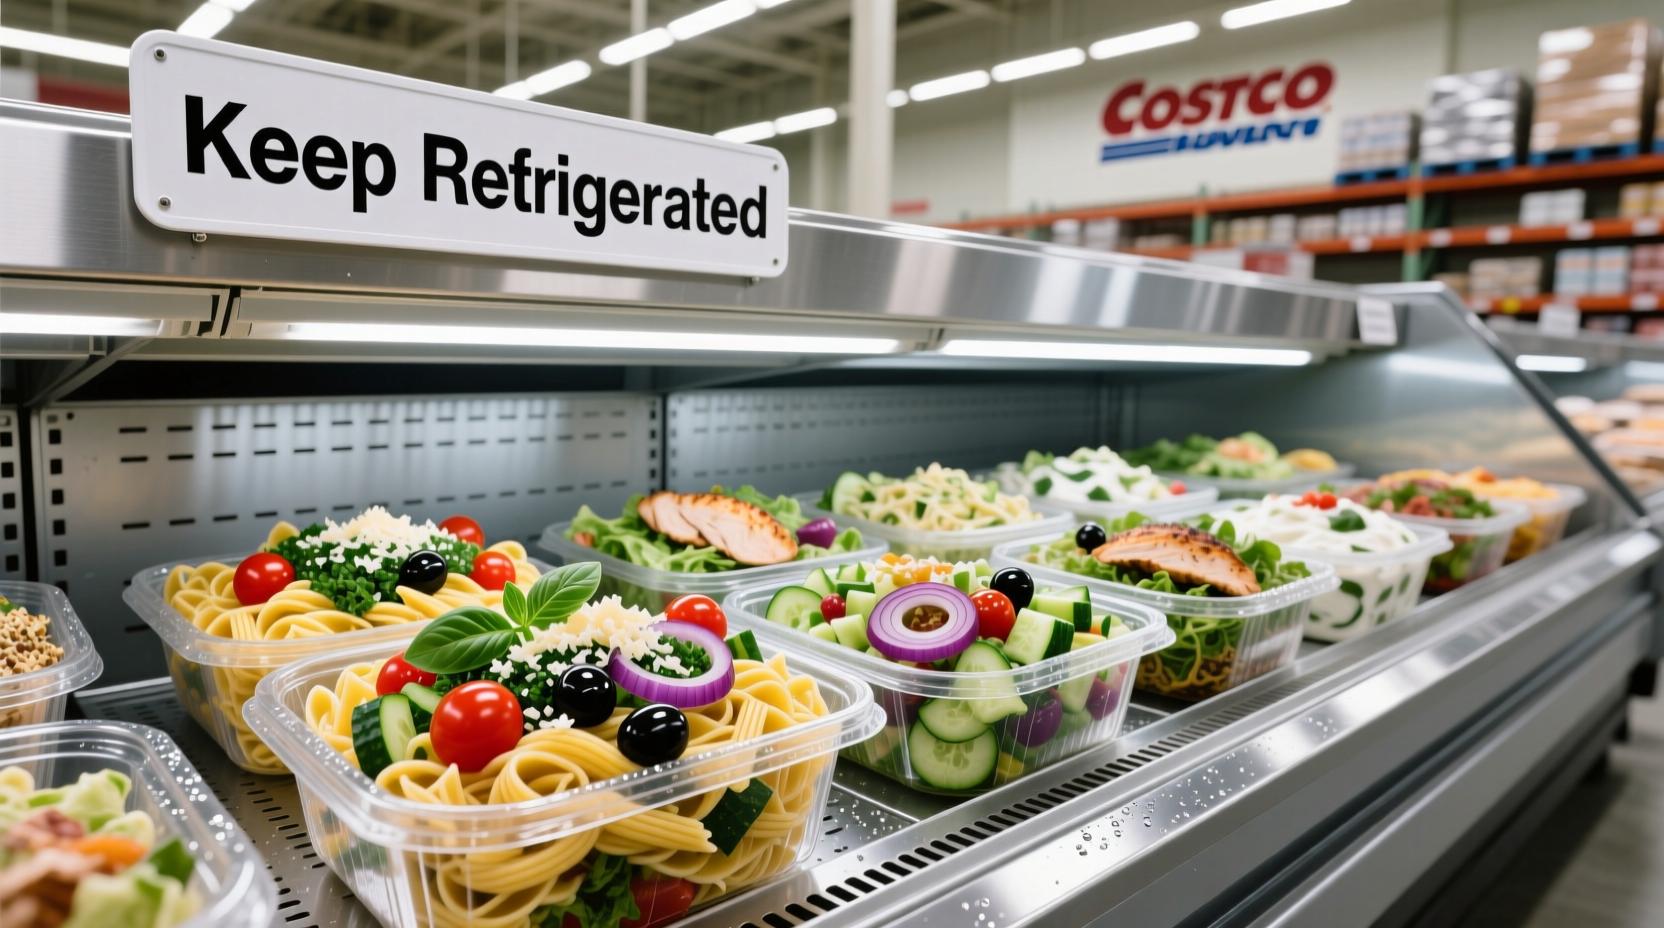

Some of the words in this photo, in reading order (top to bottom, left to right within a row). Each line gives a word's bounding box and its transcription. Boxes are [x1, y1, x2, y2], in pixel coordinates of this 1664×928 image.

[1101, 63, 1335, 137] COSTCO
[184, 95, 397, 214] Keep
[423, 132, 768, 239] Refrigerated
